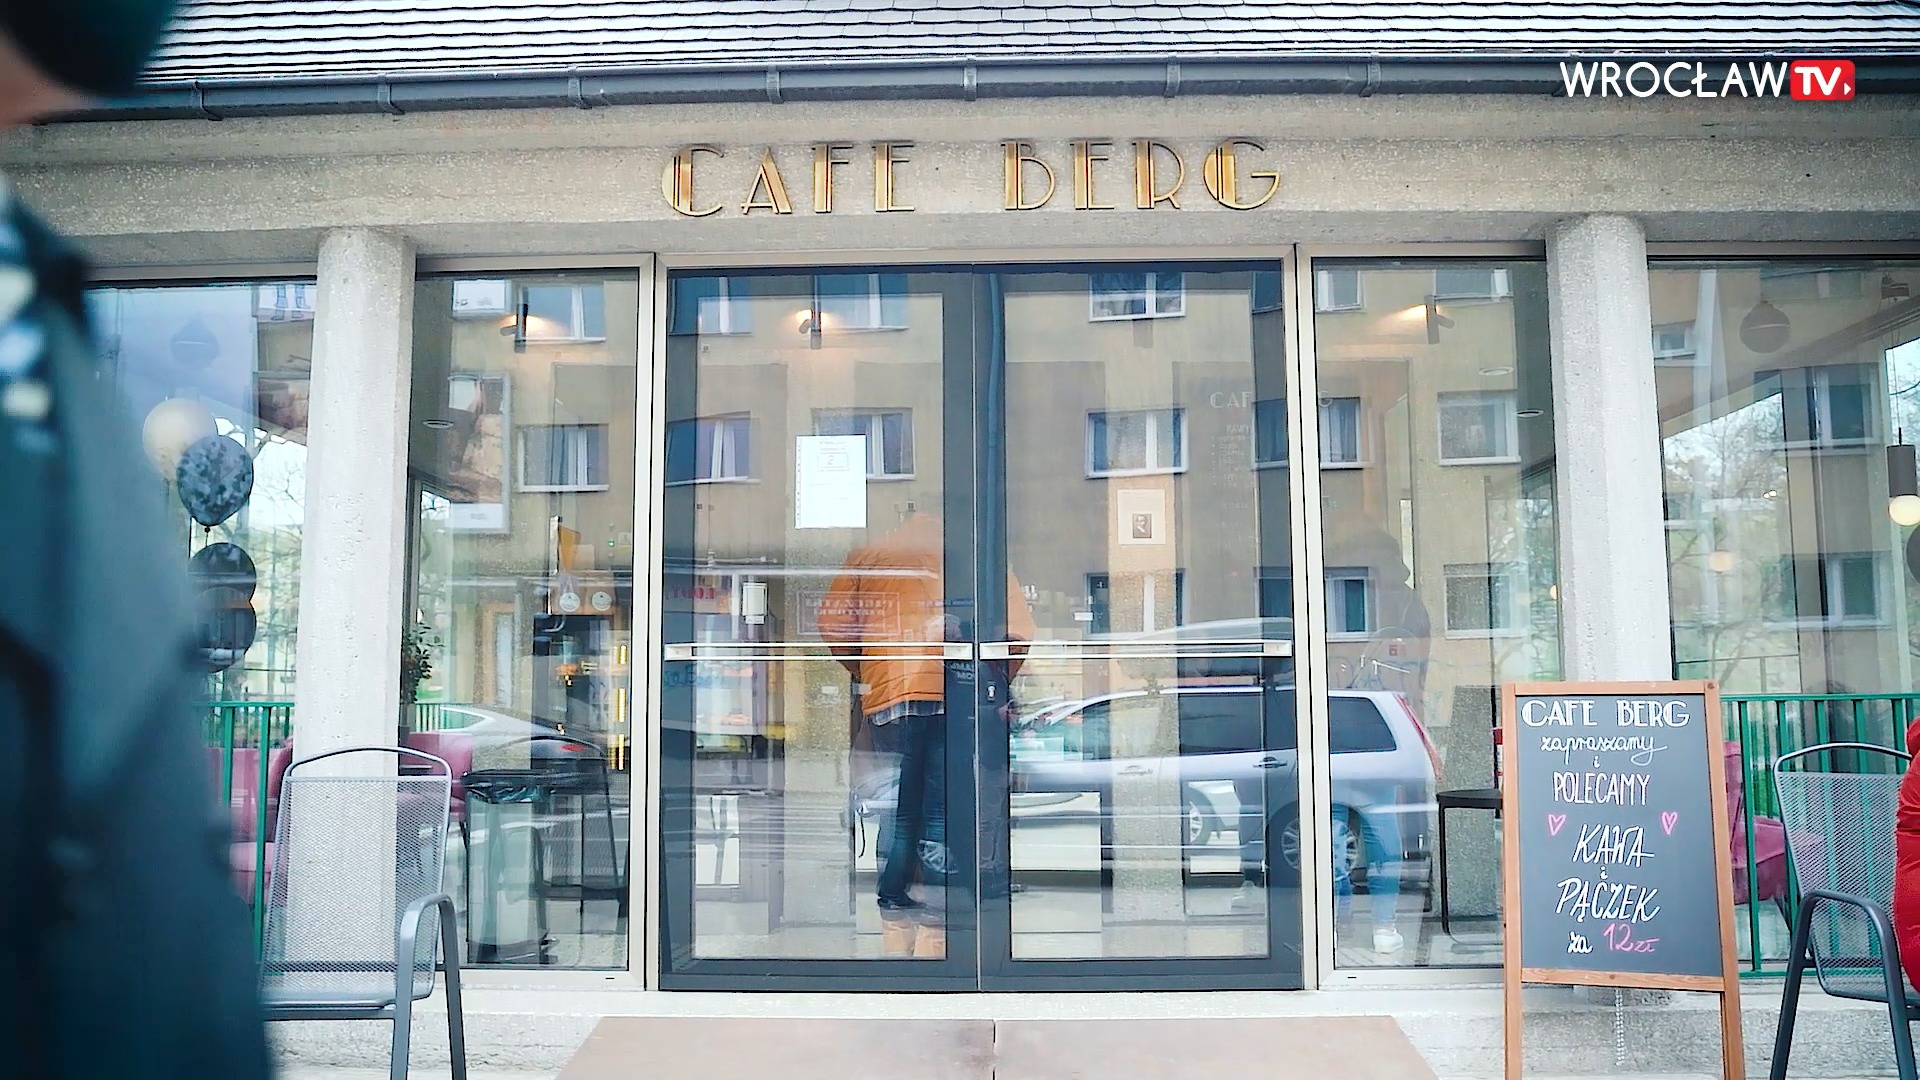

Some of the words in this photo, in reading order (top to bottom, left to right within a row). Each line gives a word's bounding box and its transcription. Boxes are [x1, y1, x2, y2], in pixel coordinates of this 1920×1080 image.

[661, 143, 915, 217] CAFE
[1001, 138, 1282, 213] BERG
[1521, 700, 1598, 727] CAFE
[1616, 700, 1691, 727] BERG
[1541, 735, 1668, 766] zapraszamy
[1592, 755, 1601, 768] i
[1553, 771, 1651, 806] POLECAMY
[1571, 823, 1655, 867] KAWA
[1600, 866, 1609, 880] i
[1555, 877, 1661, 923] PĄCZEK
